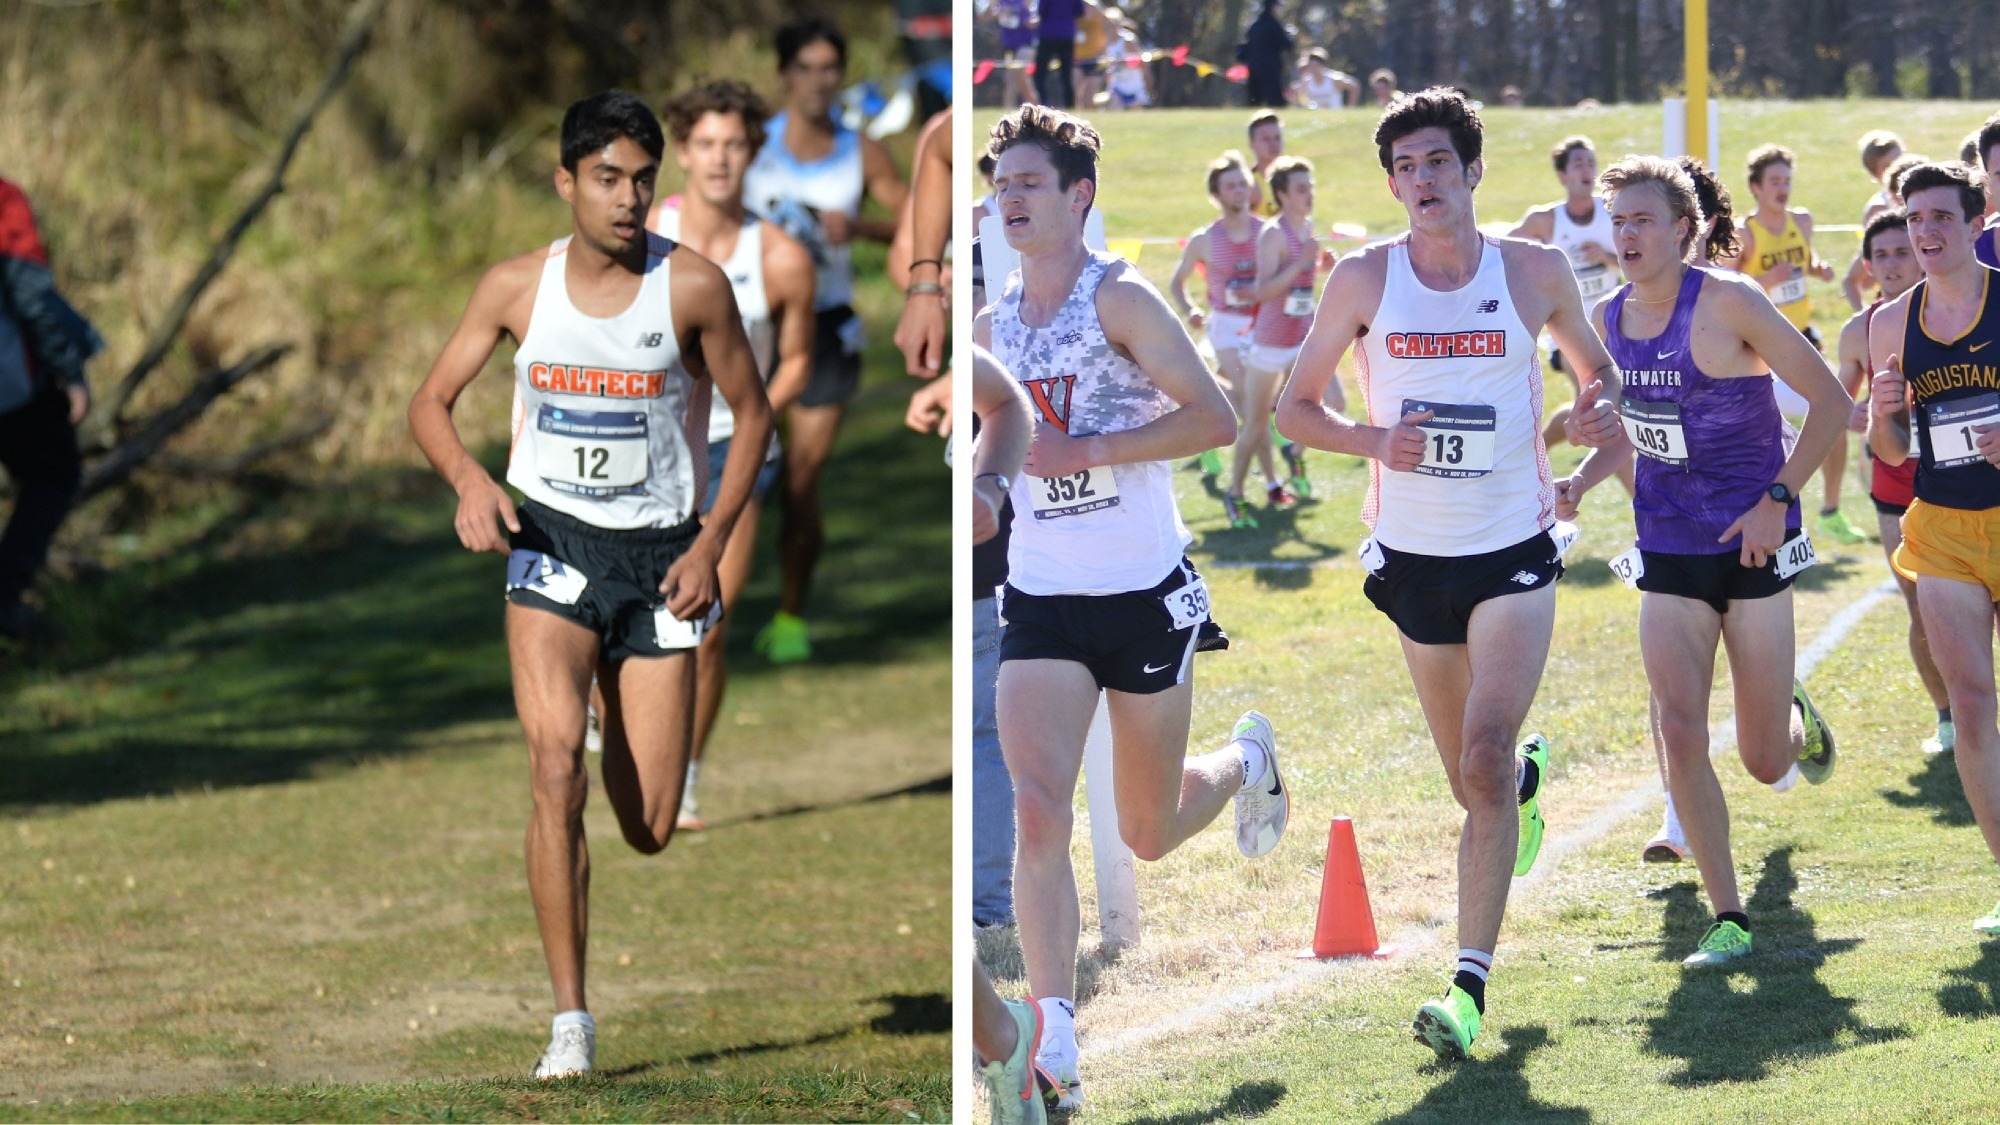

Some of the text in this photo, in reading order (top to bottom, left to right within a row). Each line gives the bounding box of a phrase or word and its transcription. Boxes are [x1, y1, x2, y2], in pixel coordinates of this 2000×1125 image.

[1386, 330, 1506, 358] CALTECH
[529, 362, 667, 399] CALTECH
[1620, 369, 1682, 386] TEWATER
[1913, 364, 2000, 402] AUGUSTAN
[1432, 416, 1454, 424] COUNTRY
[1454, 418, 1494, 426] CHAMPIONSHIPS
[1433, 433, 1464, 464] 13
[1635, 424, 1669, 453] 403
[573, 446, 609, 479] 12
[1043, 469, 1096, 503] 352
[1788, 537, 1815, 567] 403
[1613, 557, 1632, 583] 03
[1180, 586, 1208, 618] 35
